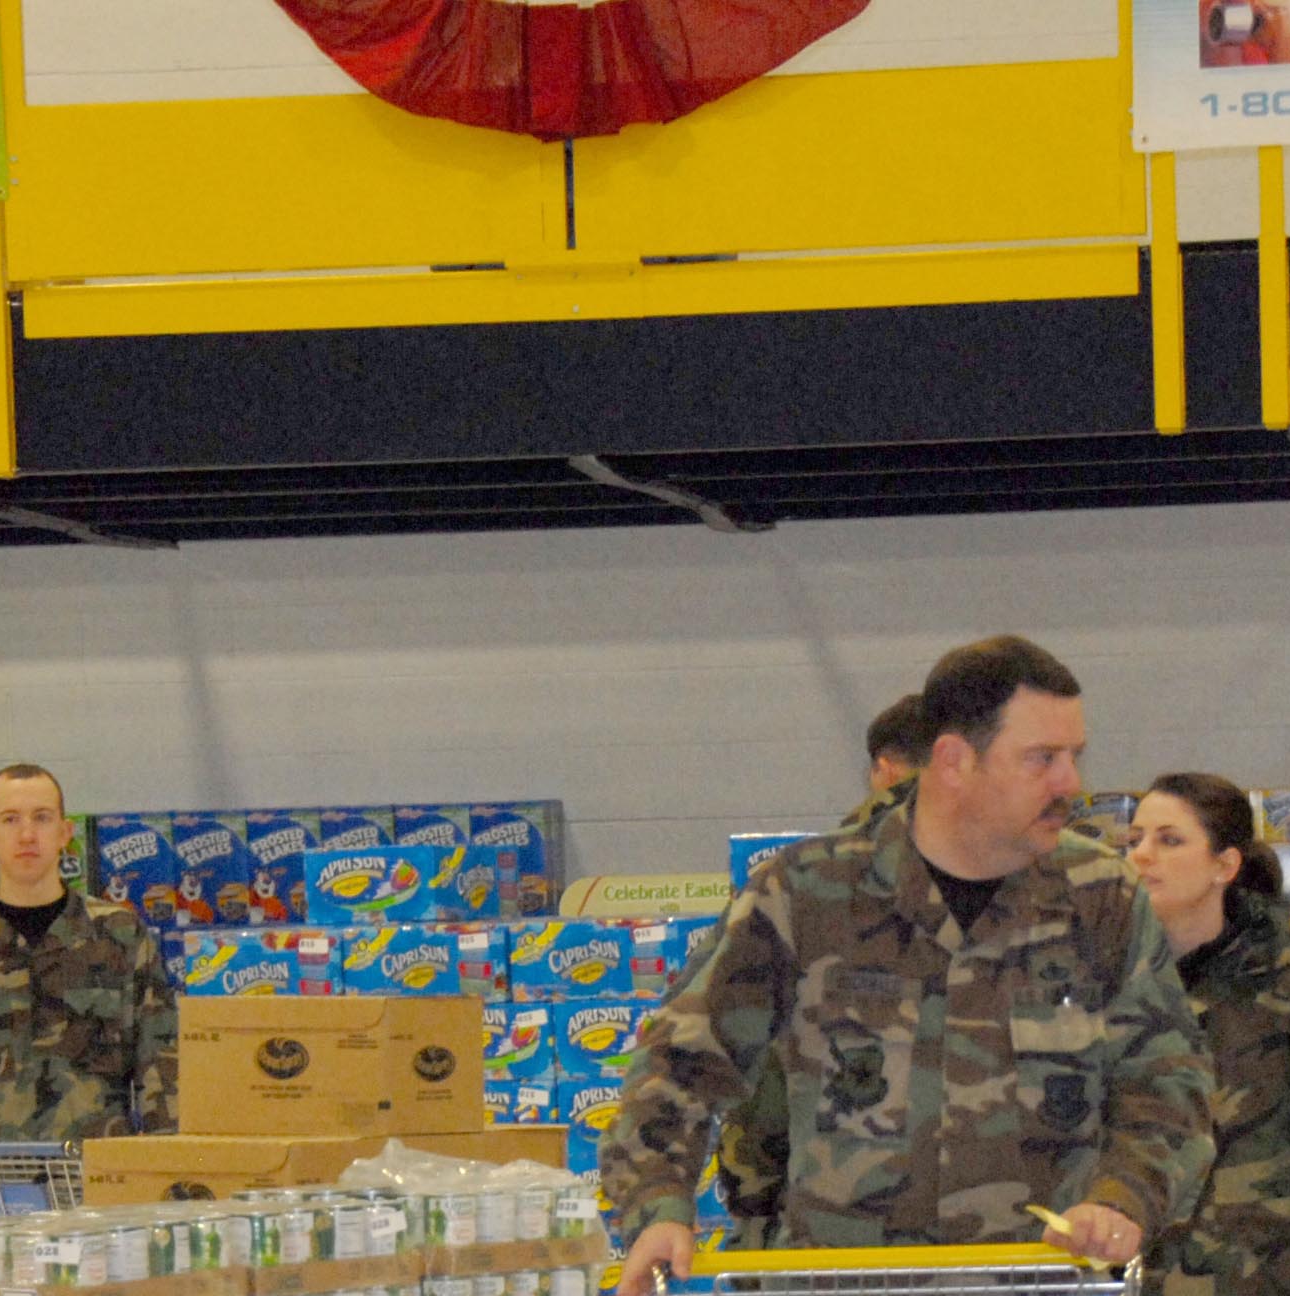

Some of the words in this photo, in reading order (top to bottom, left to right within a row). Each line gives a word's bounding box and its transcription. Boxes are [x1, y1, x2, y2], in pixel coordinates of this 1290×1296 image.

[103, 830, 158, 860] FROSTED
[176, 829, 231, 859] FROSTED
[250, 826, 305, 856] FROSTED
[258, 840, 306, 866] FLAKES
[111, 844, 159, 869] FLAKES
[185, 843, 233, 868] FLAKES
[604, 883, 679, 901] Celebrate
